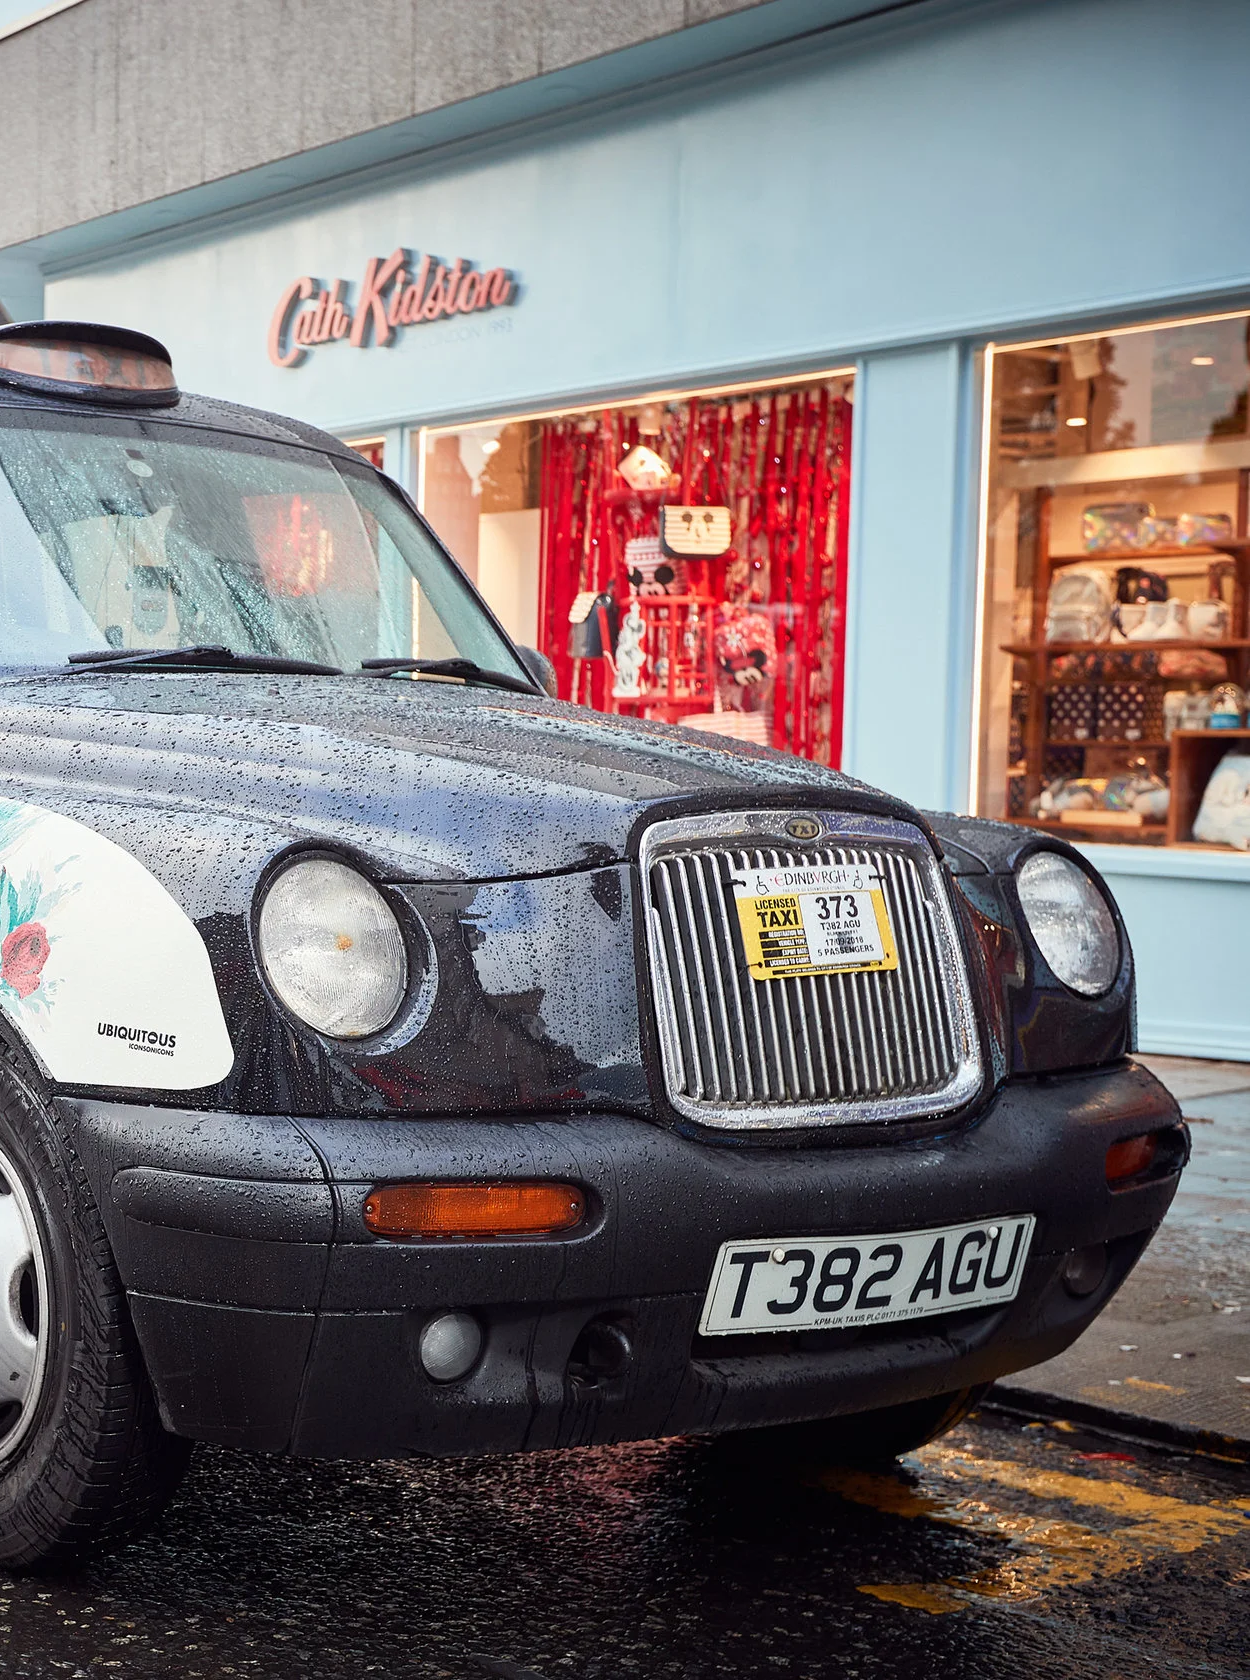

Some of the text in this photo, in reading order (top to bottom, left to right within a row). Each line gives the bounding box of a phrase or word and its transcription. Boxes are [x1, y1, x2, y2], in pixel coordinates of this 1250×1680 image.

[267, 247, 519, 369] Cath Kidston
[754, 897, 797, 910] LICENSED
[815, 894, 859, 920] 373
[757, 909, 800, 928] TAXI
[820, 919, 861, 931] T382 AGU
[817, 944, 874, 957] 5 PASSENGERS
[97, 1022, 177, 1048] UBIQUITOUS
[729, 1223, 1025, 1319] T382 AGU
[814, 1317, 843, 1326] KPM-UK
[845, 1314, 865, 1323] TAXIS
[866, 1313, 881, 1321] PLC
[881, 1311, 896, 1320] 0171
[909, 1306, 924, 1316] 1179
